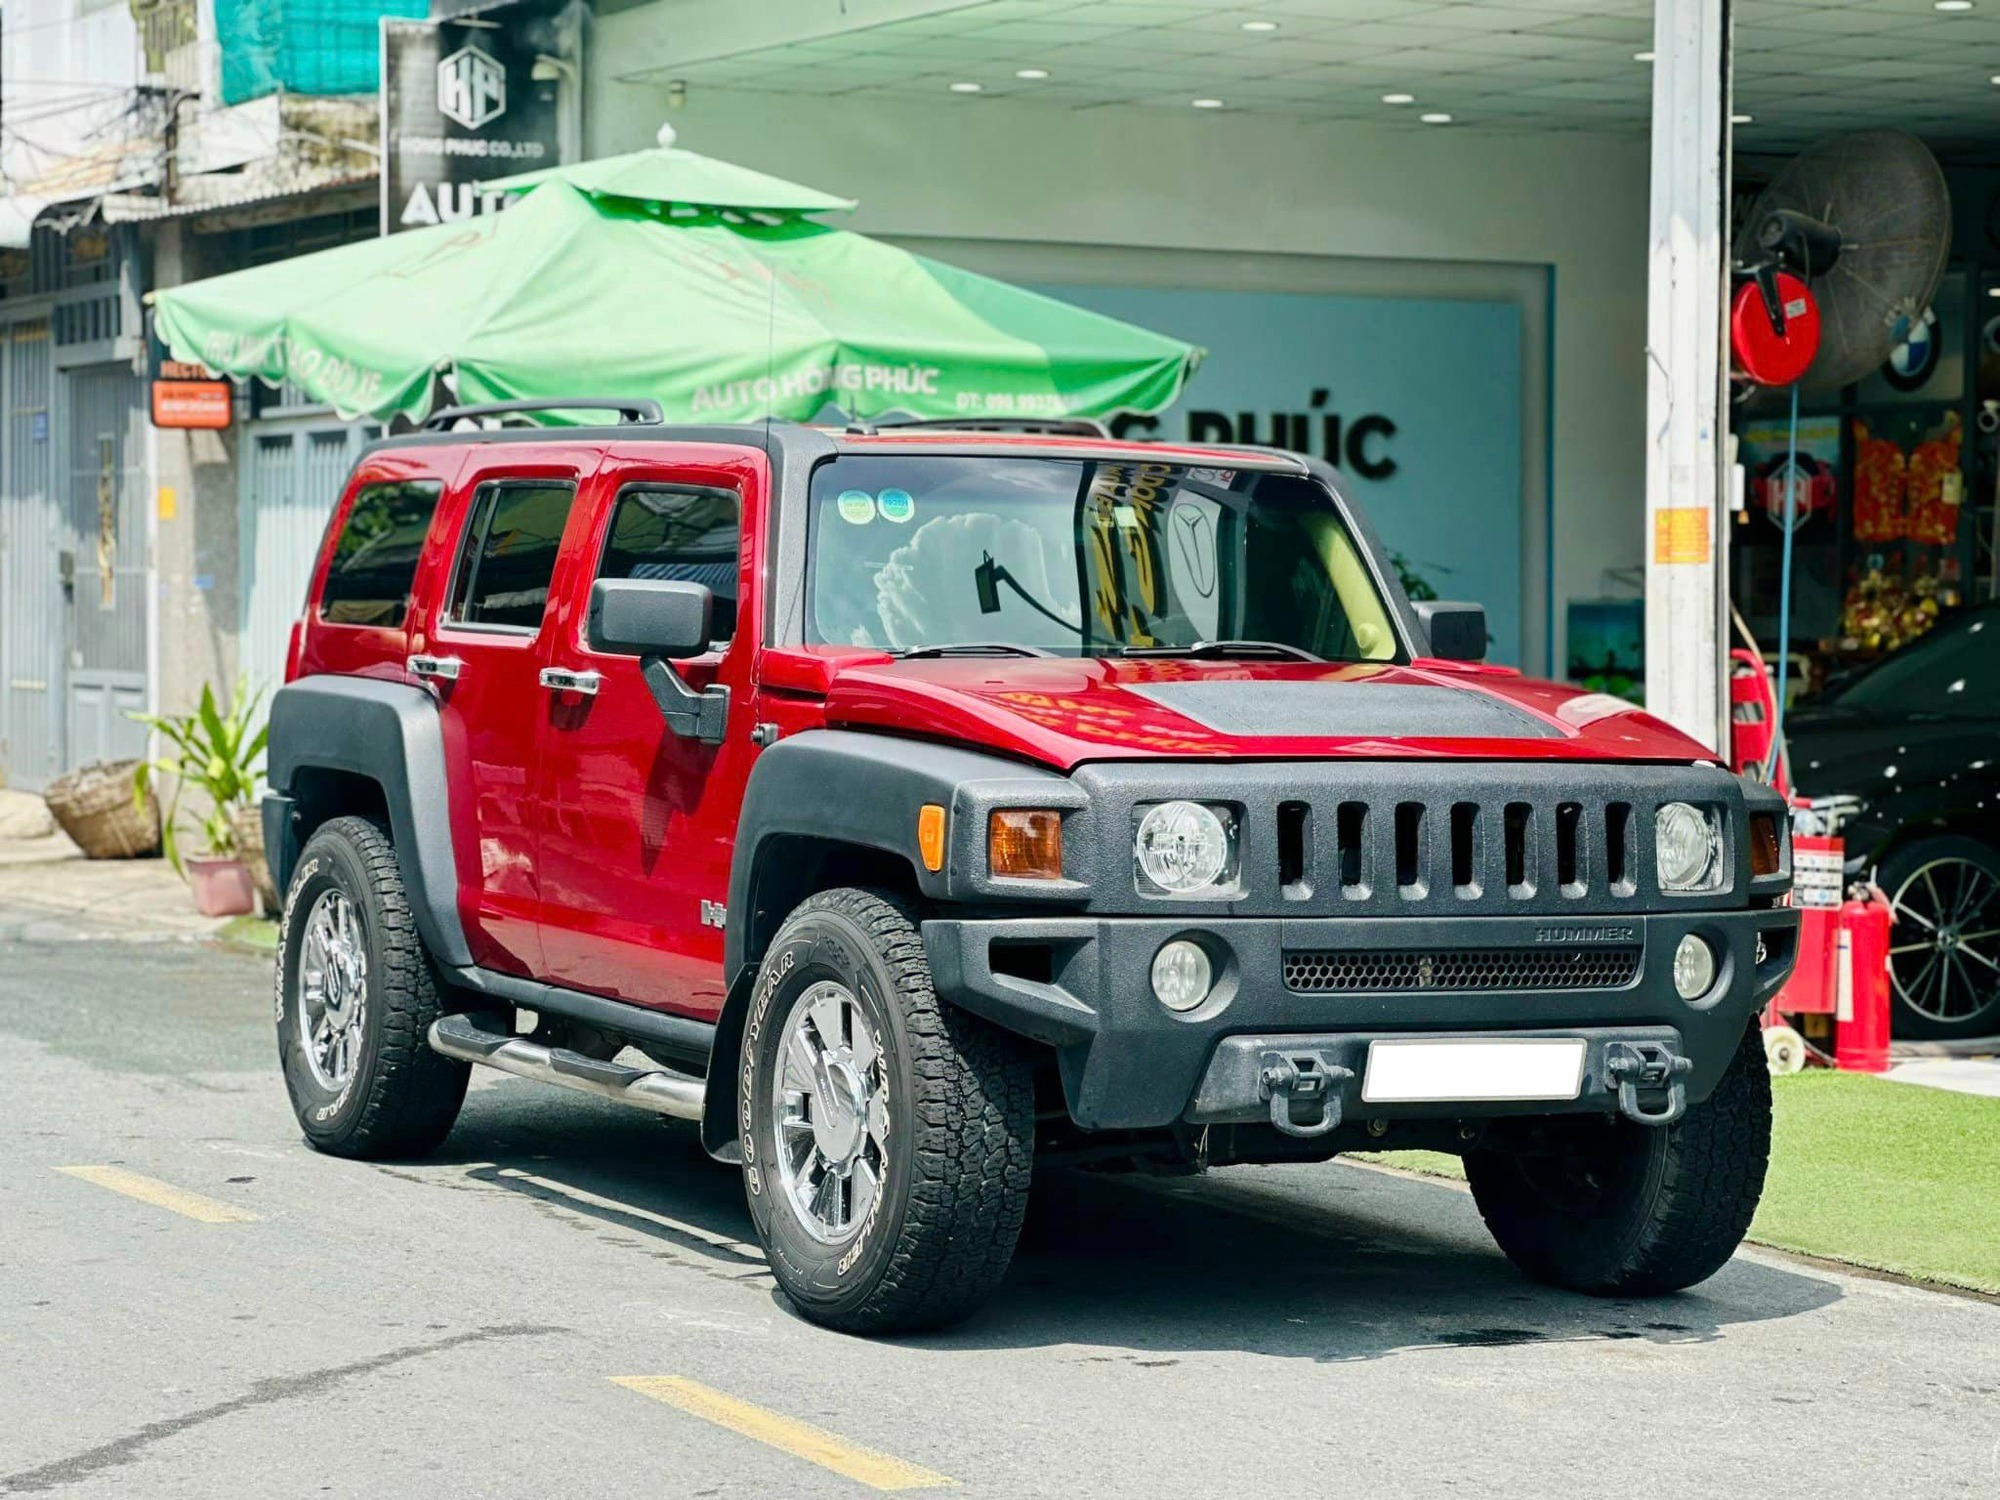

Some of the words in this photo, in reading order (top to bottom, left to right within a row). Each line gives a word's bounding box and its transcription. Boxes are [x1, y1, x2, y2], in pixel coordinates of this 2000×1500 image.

[400, 182, 526, 224] AUT
[690, 376, 778, 413] AUTO
[1535, 926, 1634, 942] HUMMER
[738, 949, 796, 1197] GOODYEAR
